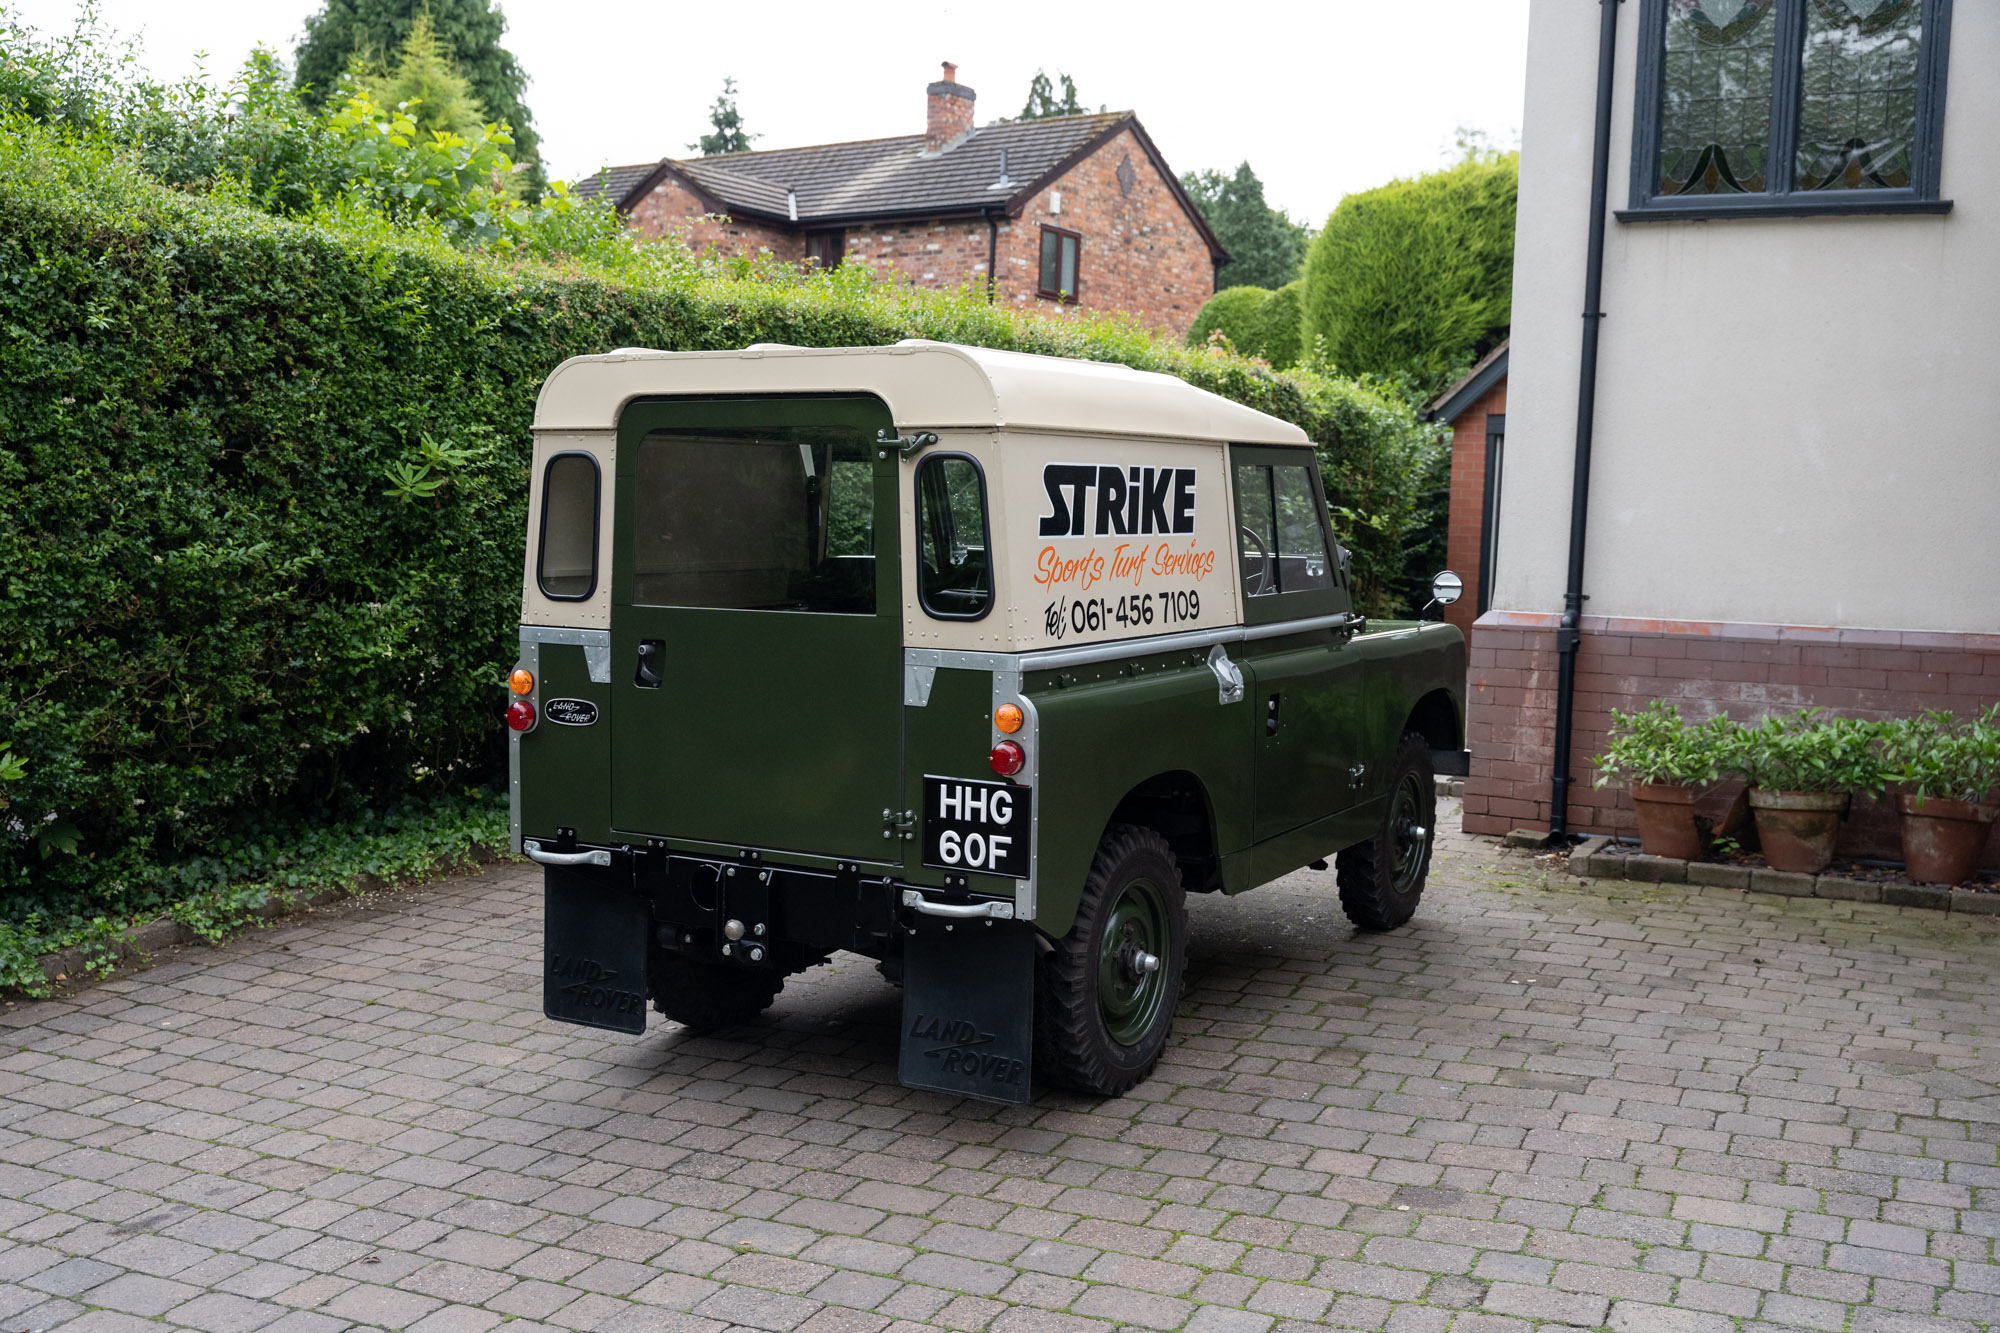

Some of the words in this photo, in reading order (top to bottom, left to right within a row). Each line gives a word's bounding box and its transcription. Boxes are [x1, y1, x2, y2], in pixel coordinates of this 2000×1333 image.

[1033, 546, 1105, 594] Sports
[1109, 544, 1149, 587] Turf
[1151, 539, 1215, 582] Services
[1071, 593, 1153, 633] 061-456
[1159, 590, 1200, 623] 7109
[553, 702, 575, 710] LAND
[565, 713, 591, 722] ROVER
[940, 784, 1013, 825] HHG
[939, 830, 1012, 869] 60F
[551, 954, 602, 980] LAND
[577, 985, 642, 1015] ROVER
[910, 1014, 976, 1043] LAND
[941, 1048, 1025, 1085] ROVER
